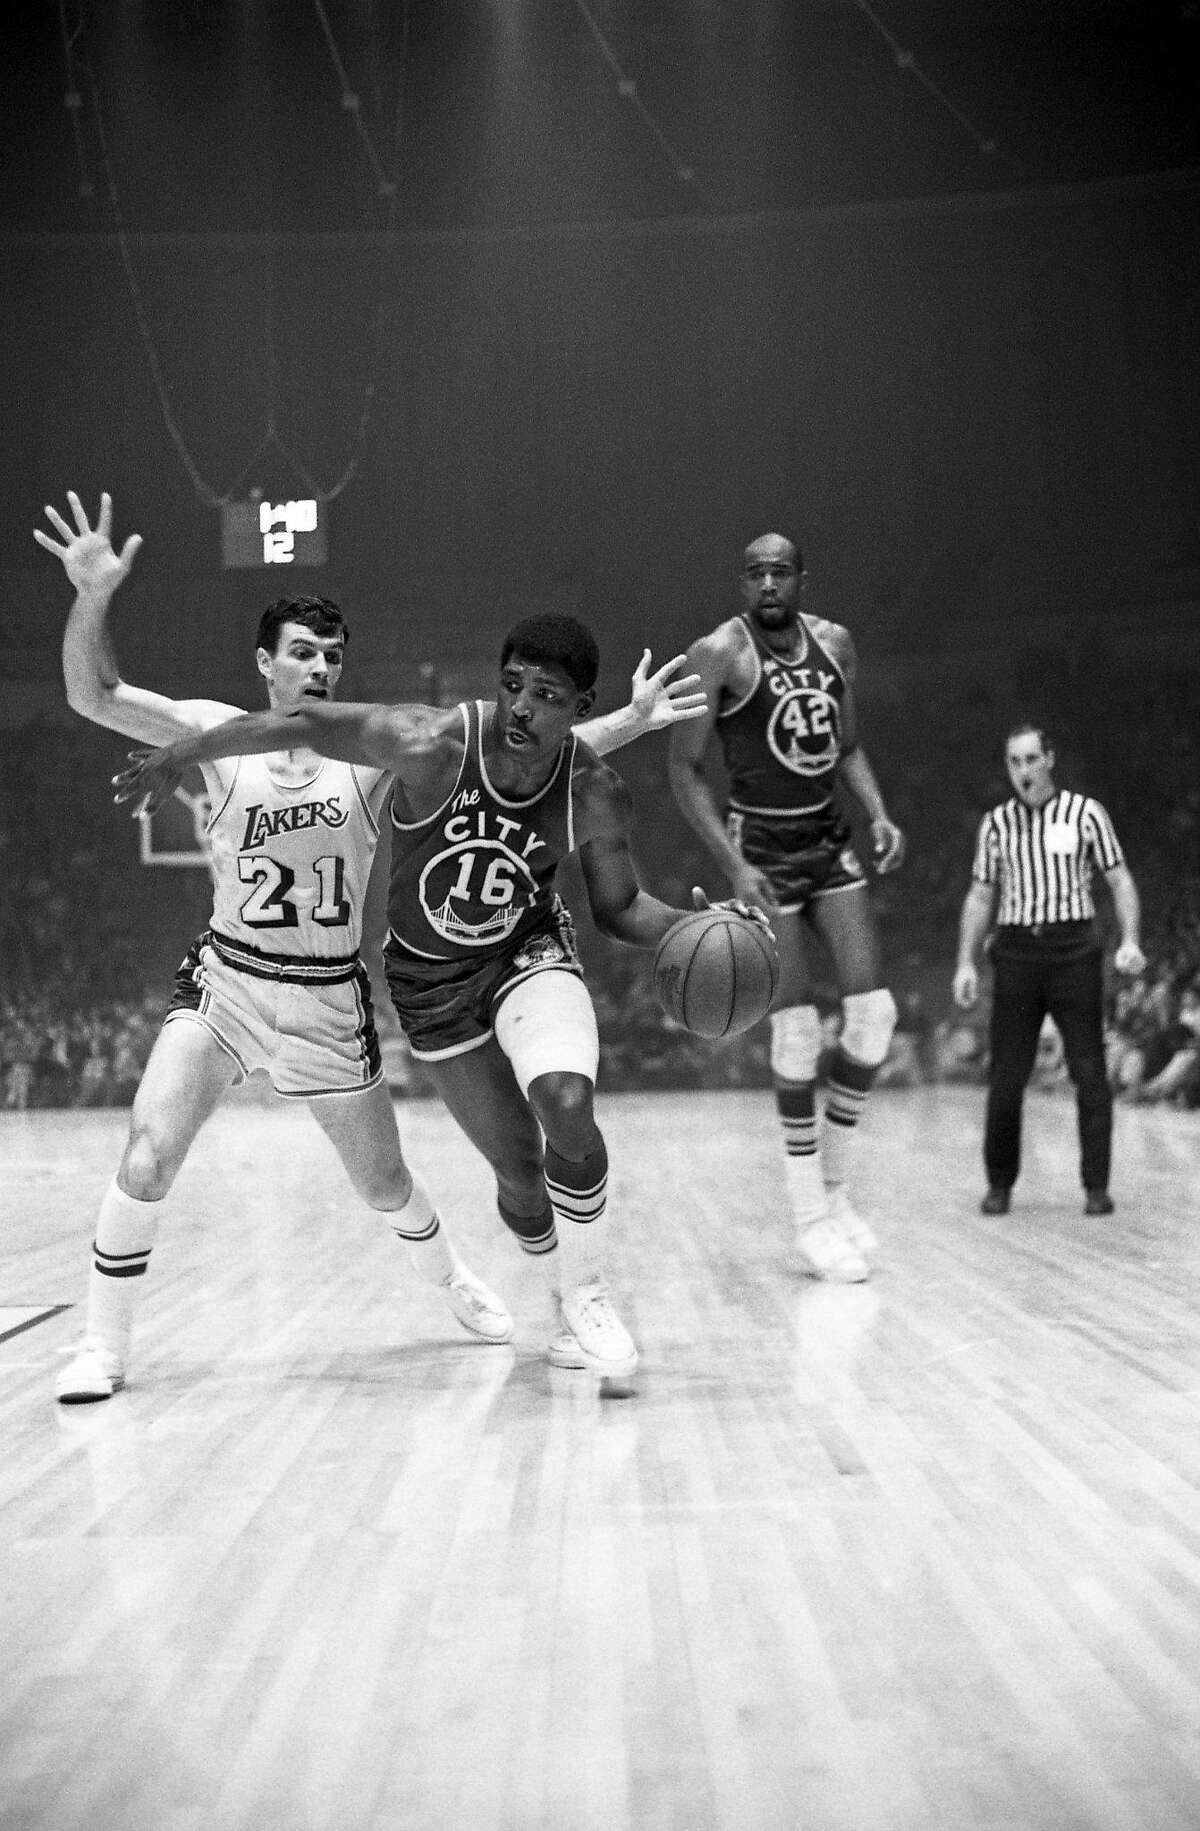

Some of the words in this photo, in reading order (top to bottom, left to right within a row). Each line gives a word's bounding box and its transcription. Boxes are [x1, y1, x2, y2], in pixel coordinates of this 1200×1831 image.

[263, 532, 294, 563] 12
[768, 668, 835, 696] CITY
[782, 697, 831, 737] 42
[451, 788, 481, 814] The
[239, 796, 349, 852] LAKERS
[444, 811, 546, 859] CITY
[237, 855, 350, 929] 21
[449, 852, 517, 906] 16
